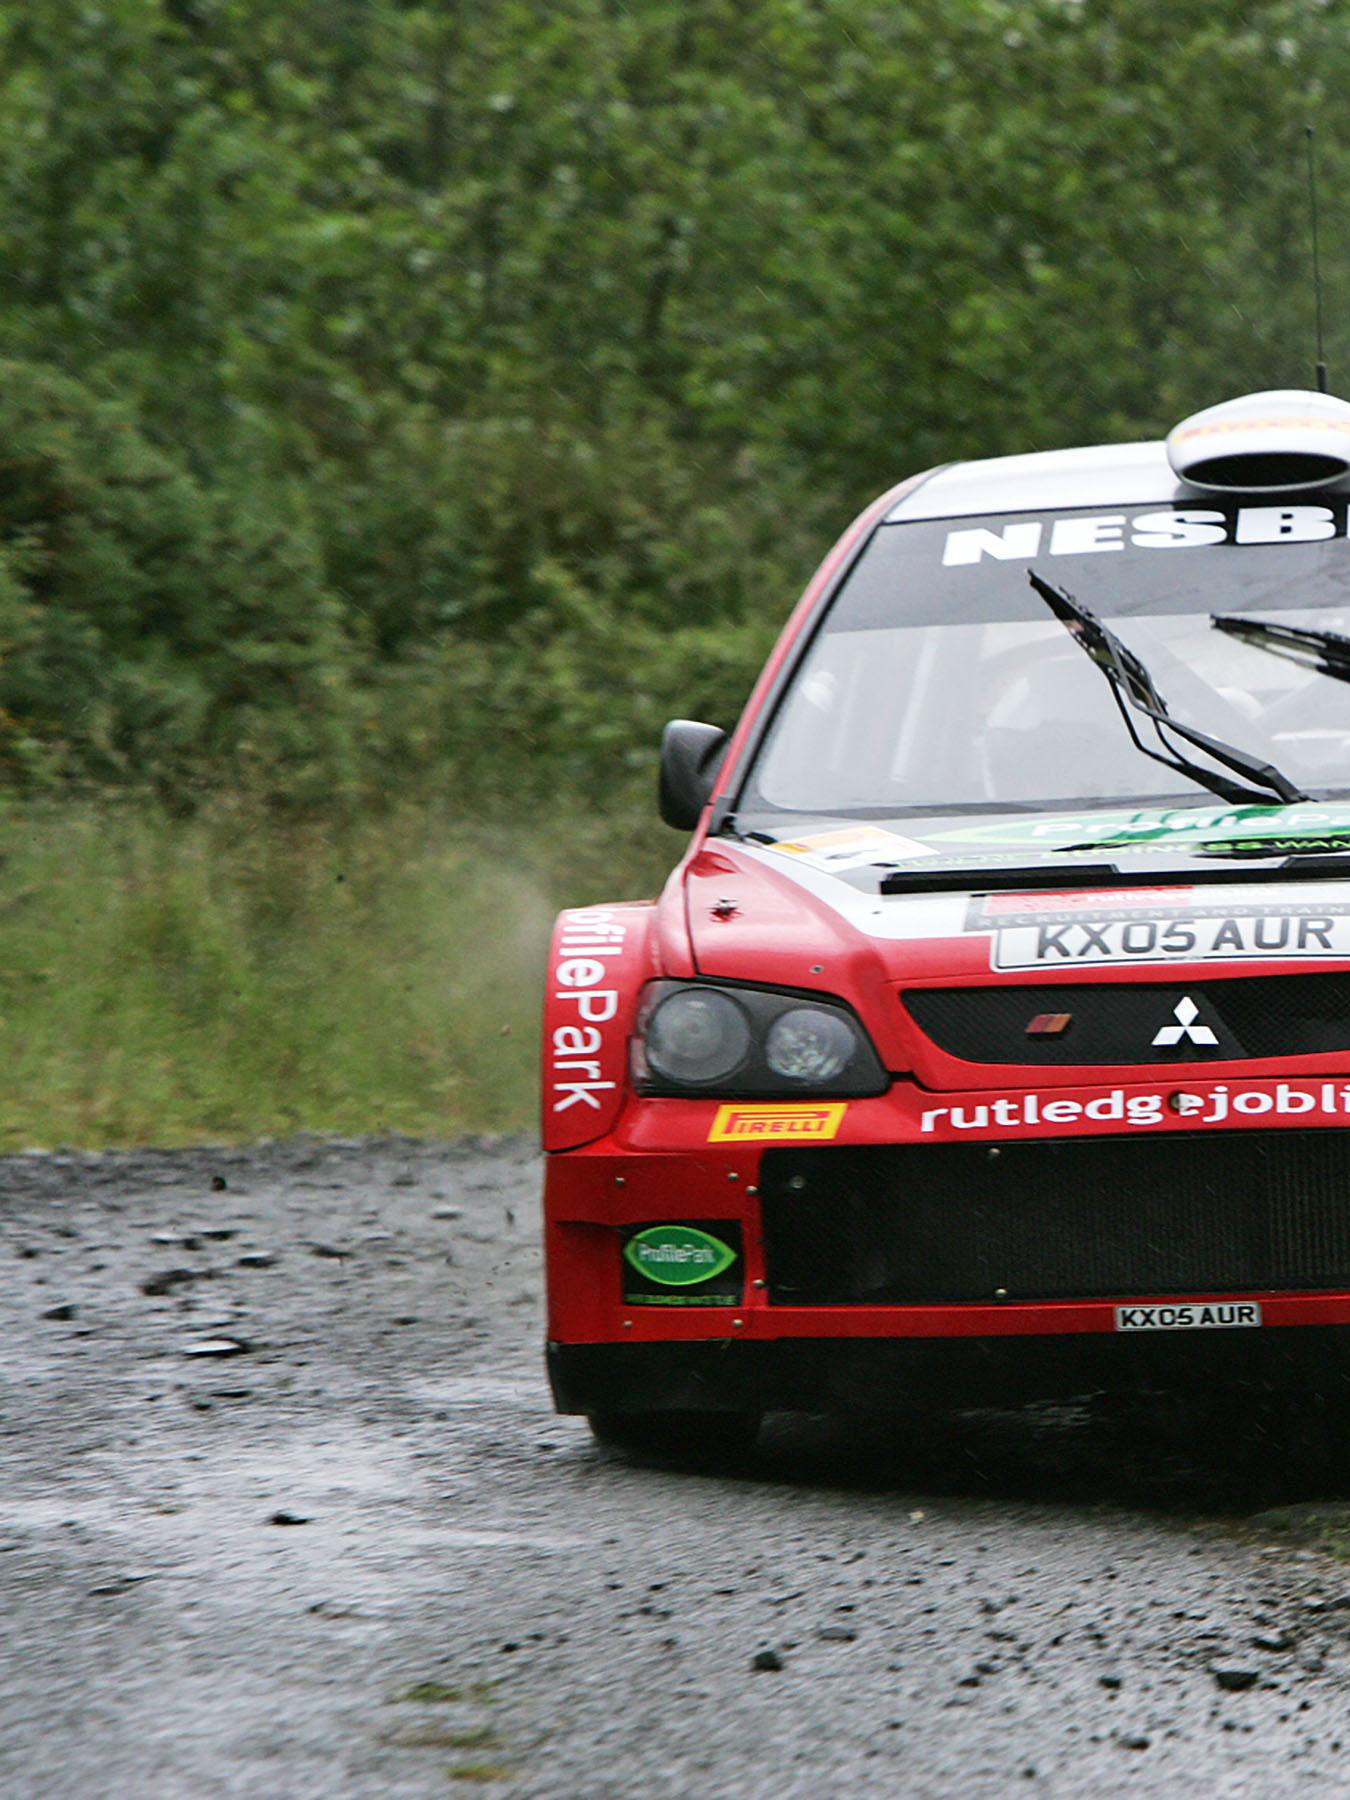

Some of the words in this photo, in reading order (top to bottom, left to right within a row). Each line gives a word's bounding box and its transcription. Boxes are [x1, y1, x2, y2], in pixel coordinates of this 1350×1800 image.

[979, 907, 1178, 927] RECRUITMENT
[1199, 906, 1255, 917] AND
[1036, 920, 1196, 959] KX05
[1212, 916, 1335, 951] AUR
[724, 1110, 829, 1136] PIRELLI
[1120, 1307, 1195, 1327] KX05
[1200, 1305, 1255, 1325] AUR
